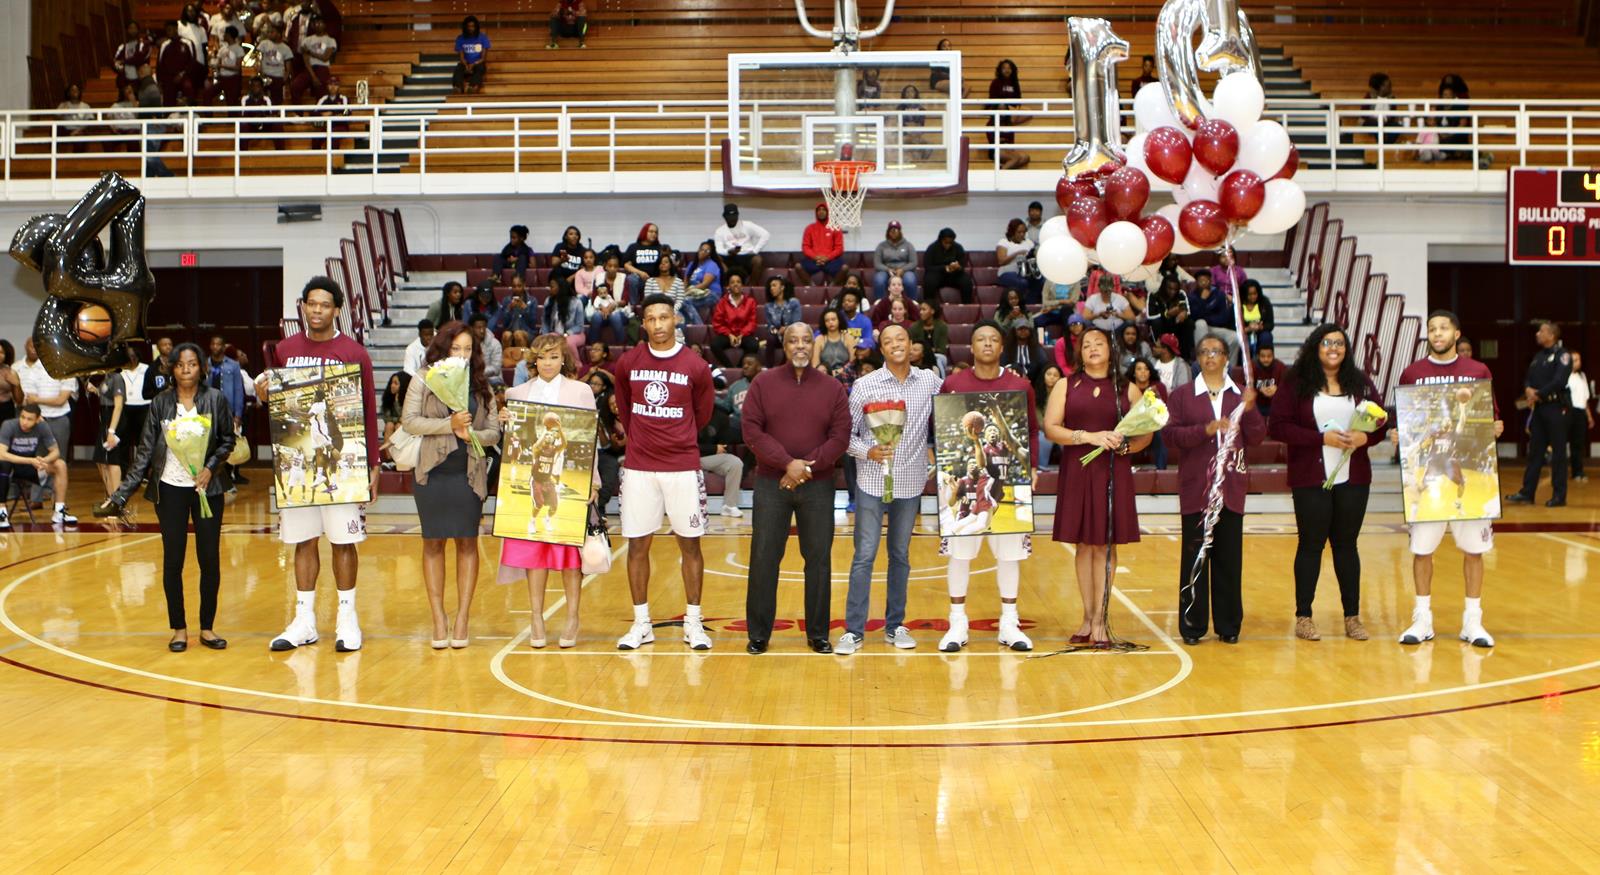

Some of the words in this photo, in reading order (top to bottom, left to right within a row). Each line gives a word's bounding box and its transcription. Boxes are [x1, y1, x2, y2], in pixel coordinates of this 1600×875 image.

[1519, 207, 1586, 222] BULLDOGS
[1548, 226, 1565, 255] 0
[182, 254, 196, 266] EXIT
[286, 356, 321, 367] ALABAMA
[630, 370, 667, 382] ALABAMA
[668, 372, 688, 385] A&M
[632, 402, 683, 418] BULLDOGS
[539, 462, 551, 474] 30
